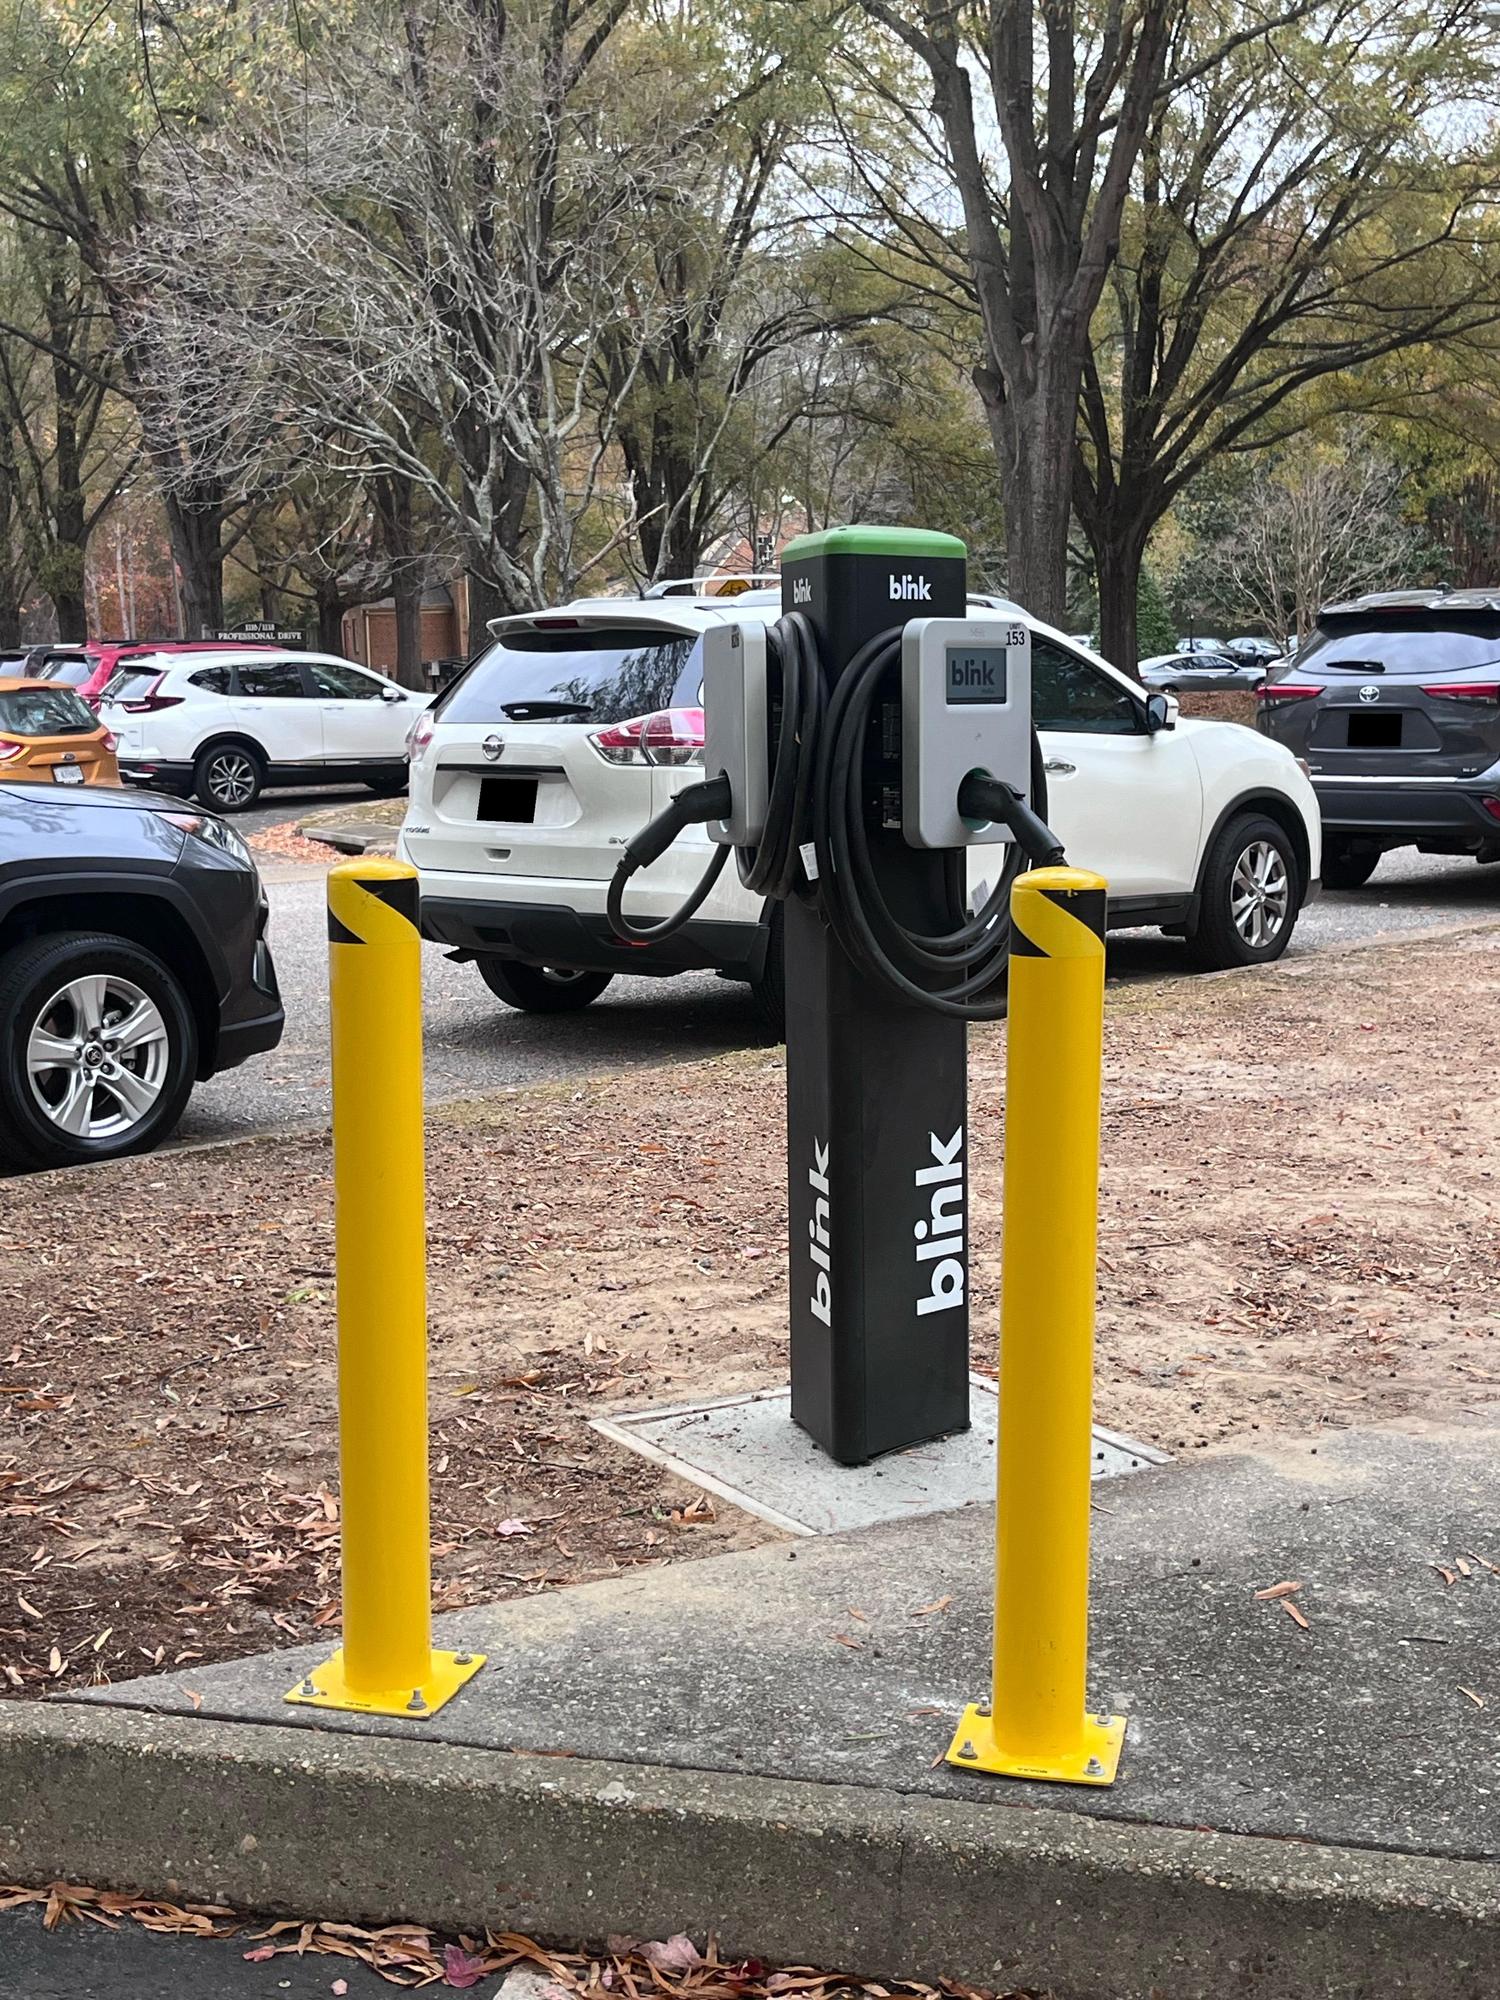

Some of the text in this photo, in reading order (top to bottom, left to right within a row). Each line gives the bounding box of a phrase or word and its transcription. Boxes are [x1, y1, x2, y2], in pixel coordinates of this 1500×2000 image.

[793, 577, 812, 604] blink
[889, 574, 932, 600] blink
[218, 631, 302, 640] PROFESSIONAL DRIVE
[1005, 631, 1025, 646] 153
[951, 659, 995, 686] blink
[808, 1135, 832, 1328] blink
[914, 1125, 965, 1316] blink
